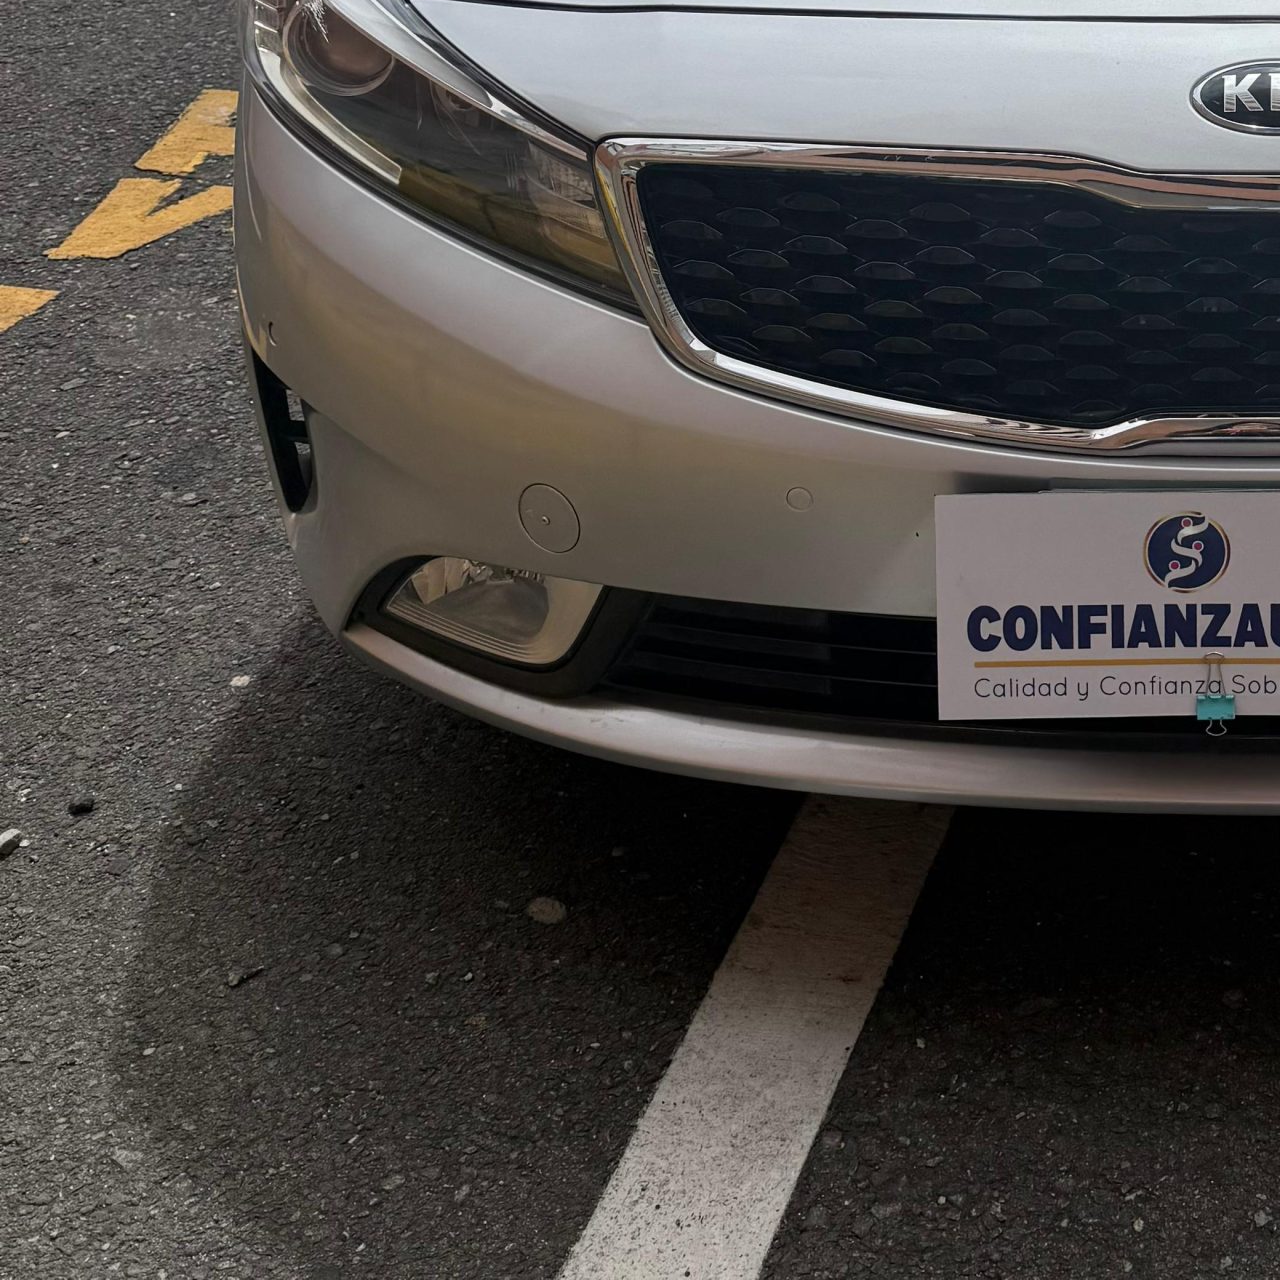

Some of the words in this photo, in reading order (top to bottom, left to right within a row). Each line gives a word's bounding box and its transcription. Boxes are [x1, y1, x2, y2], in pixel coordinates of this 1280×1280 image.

[974, 676, 1068, 699] Calidad
[1076, 678, 1090, 702] y
[1100, 675, 1223, 697] Confianza
